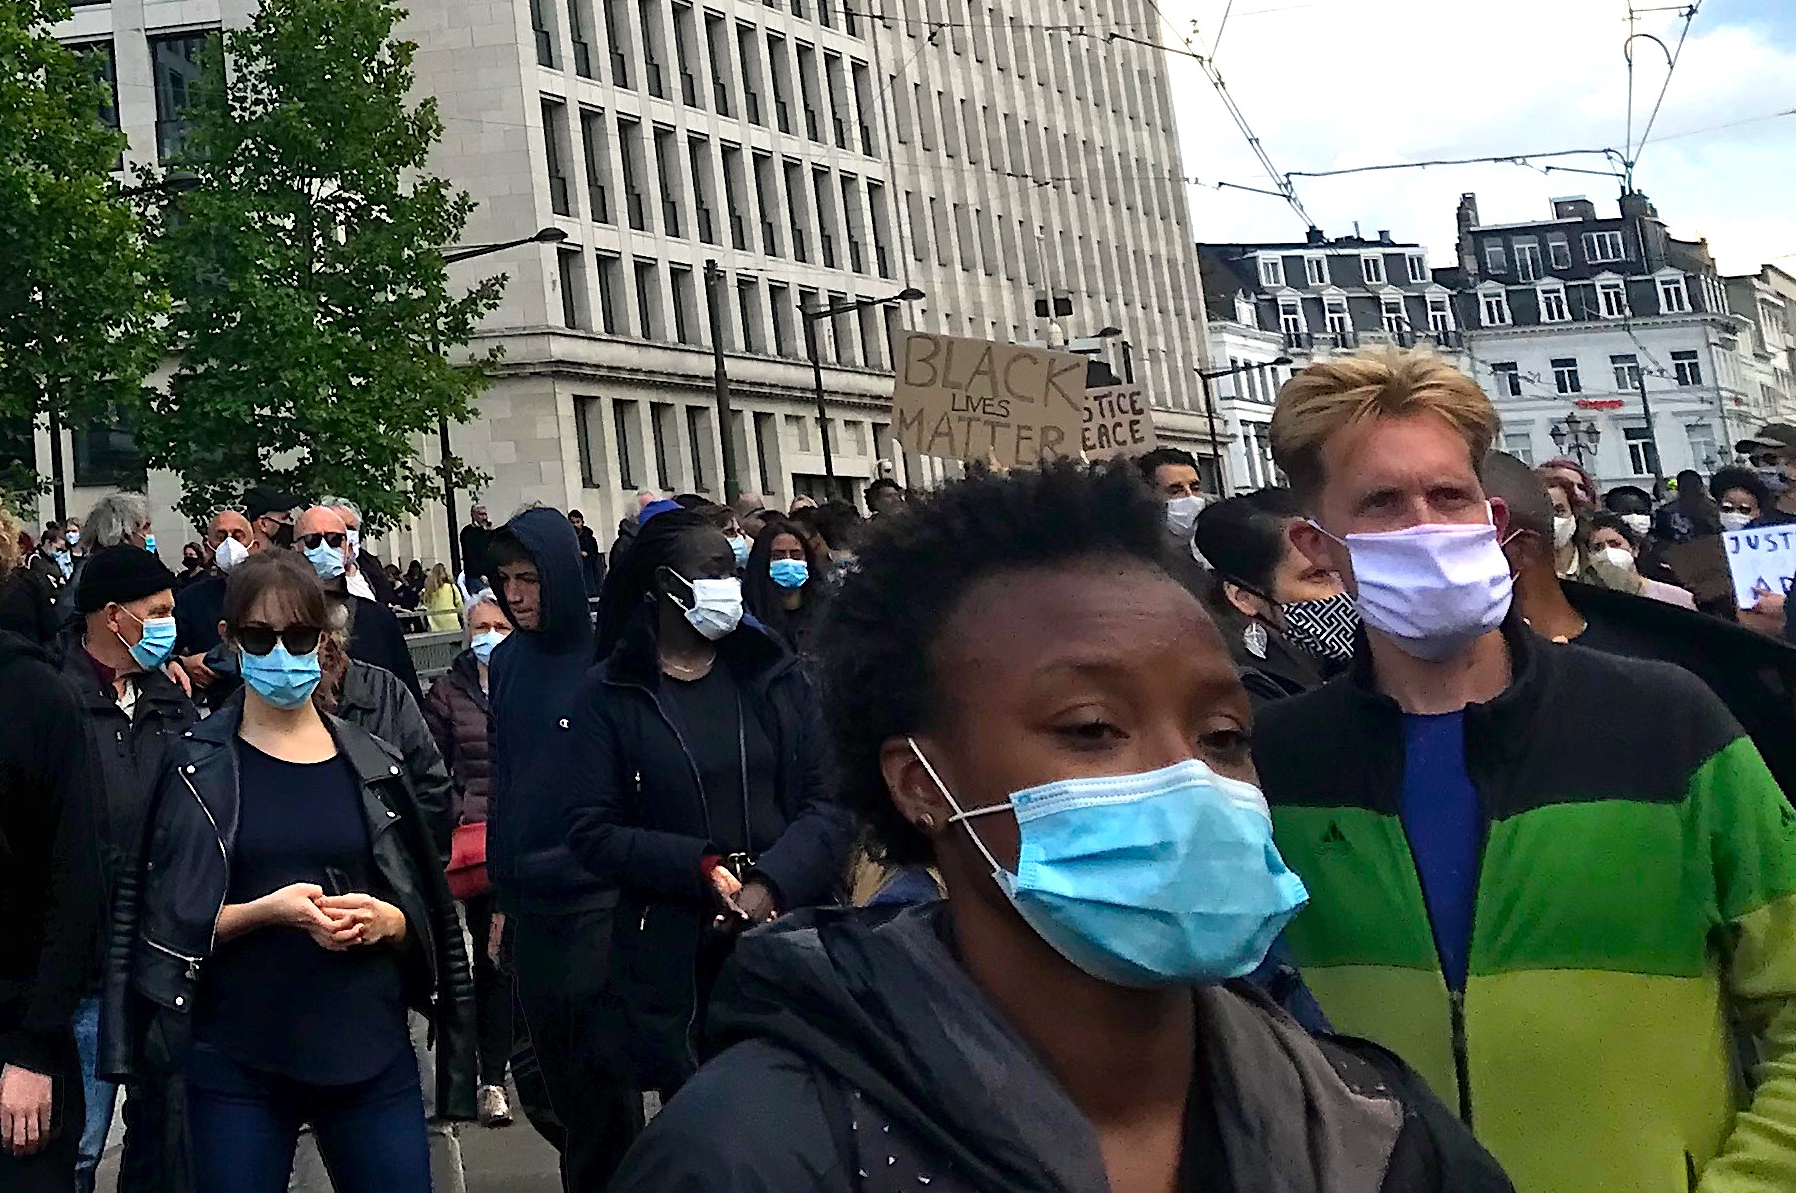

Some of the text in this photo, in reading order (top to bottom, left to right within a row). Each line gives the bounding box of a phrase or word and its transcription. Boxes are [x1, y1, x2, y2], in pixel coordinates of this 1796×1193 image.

[904, 333, 1082, 412] BLACK
[951, 392, 1010, 418] LIVES
[897, 407, 1066, 467] MATTER
[1729, 531, 1796, 554] JUST
